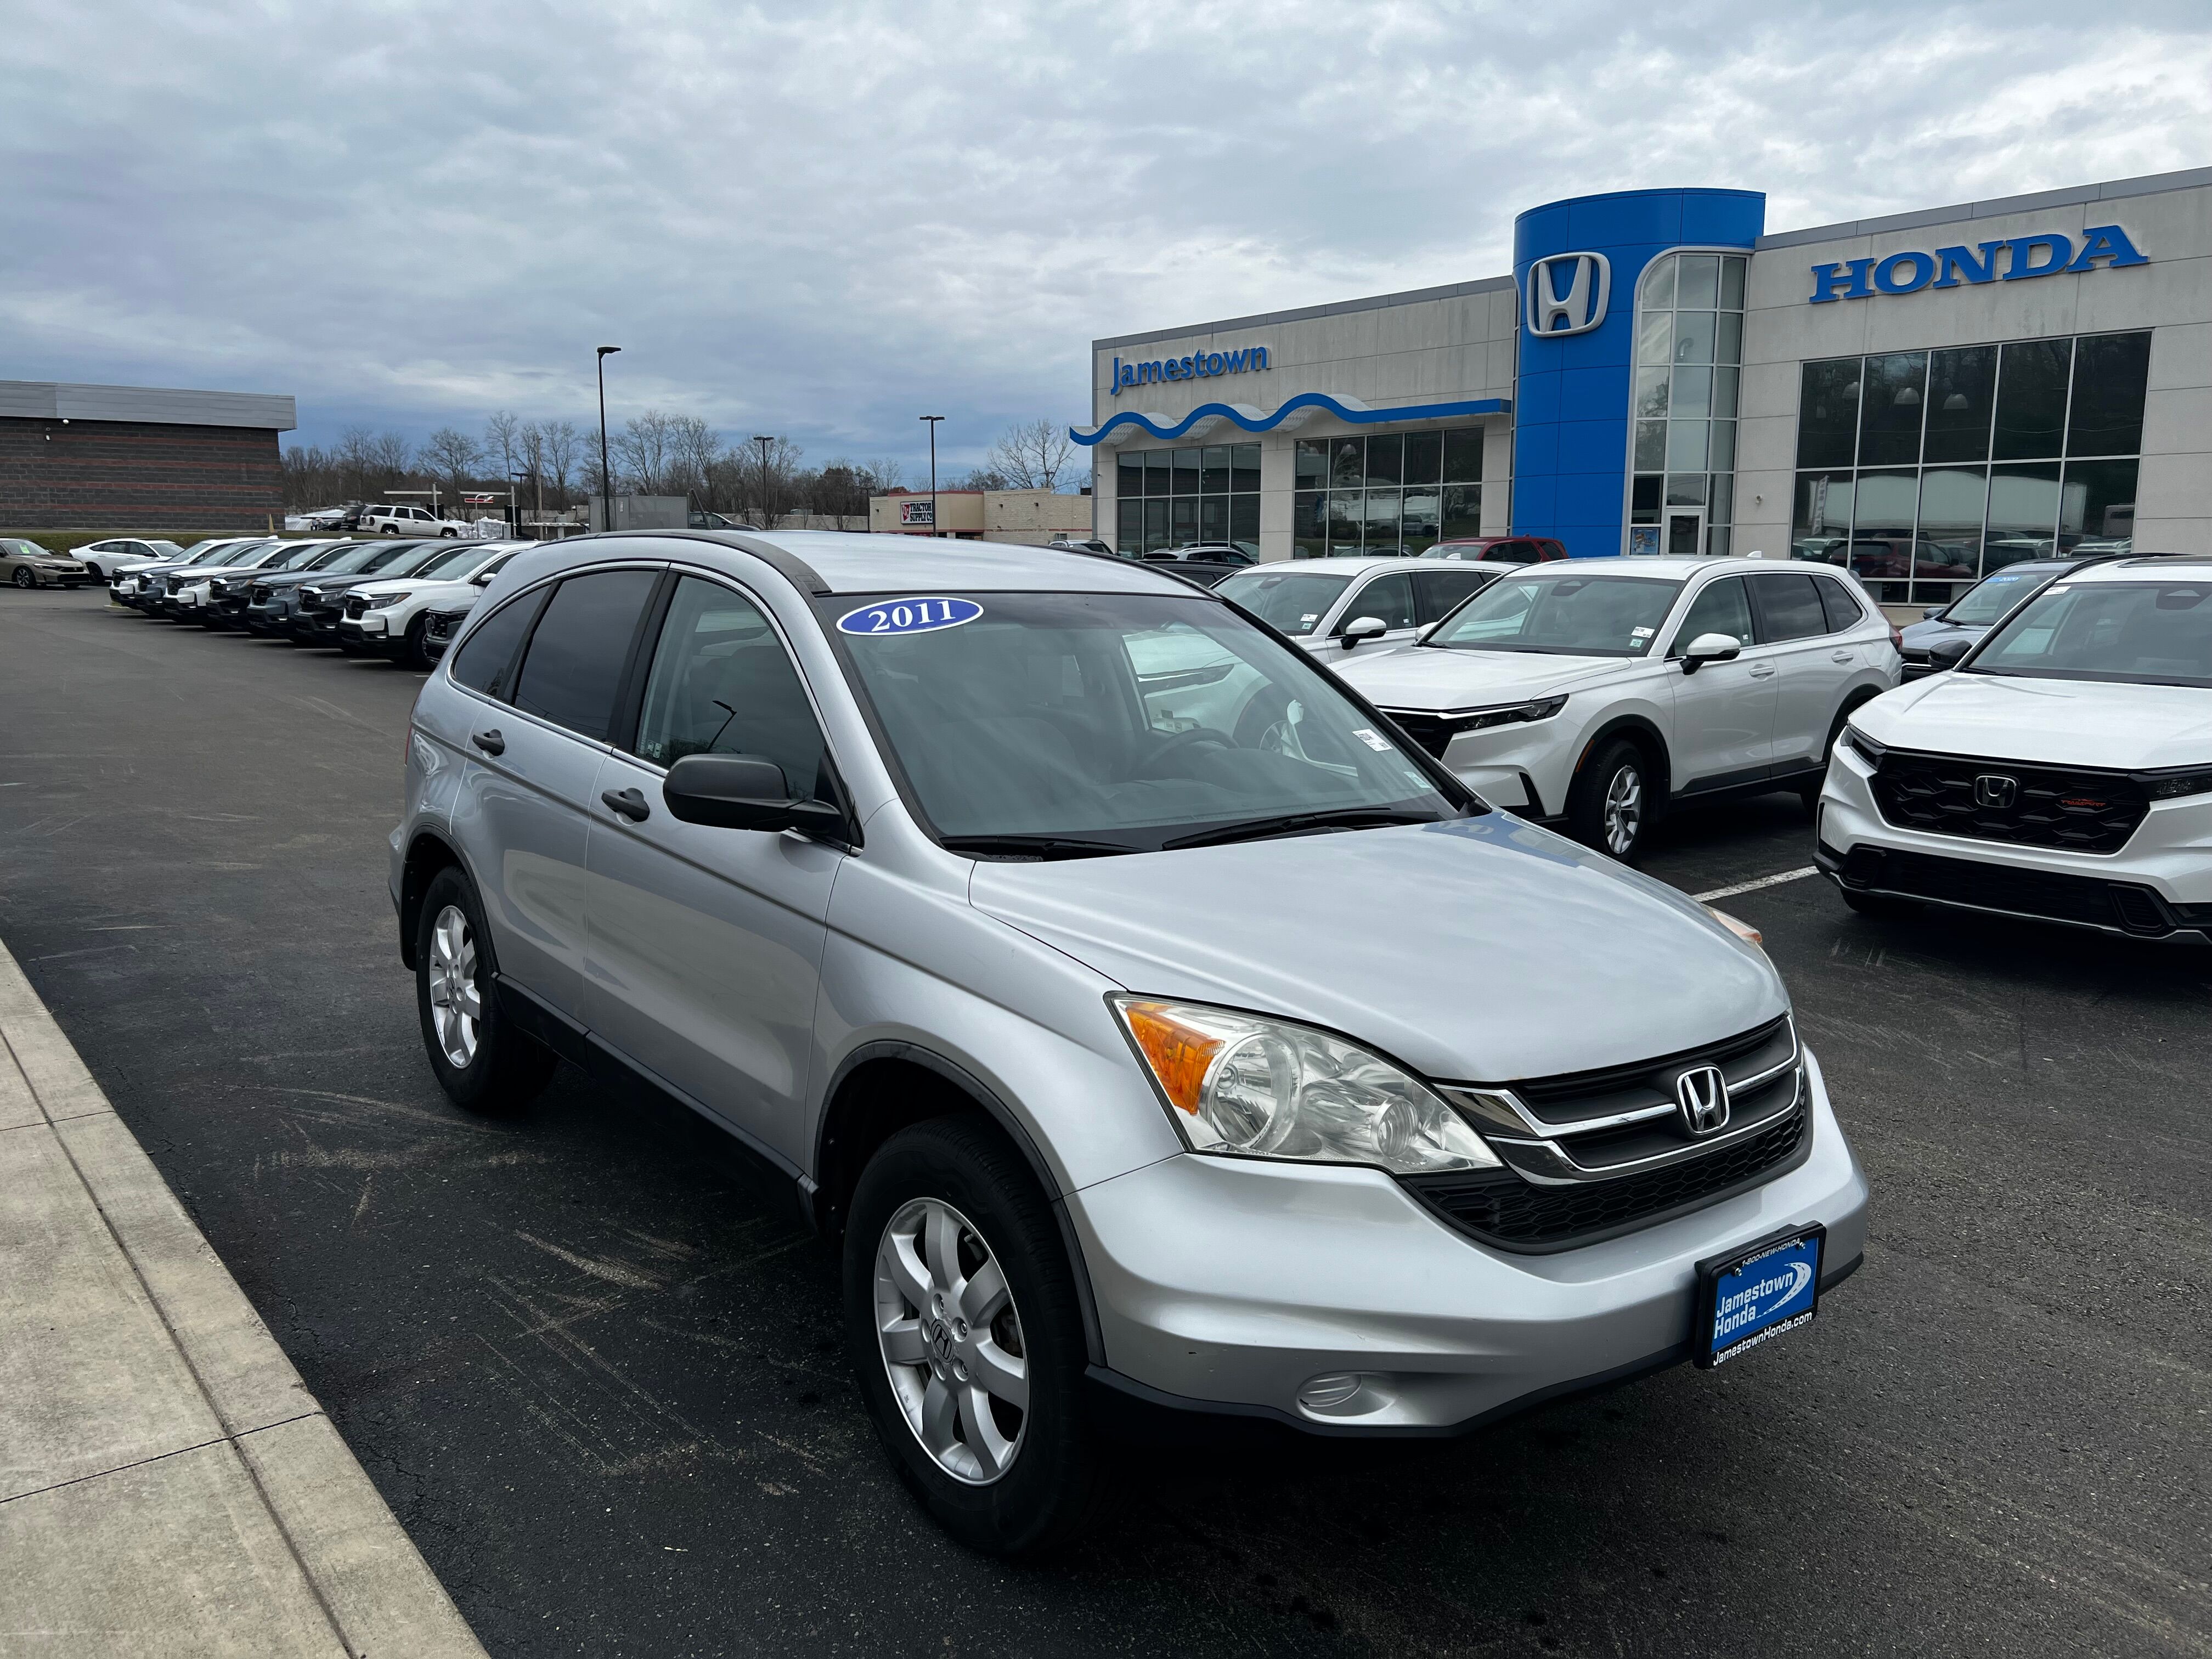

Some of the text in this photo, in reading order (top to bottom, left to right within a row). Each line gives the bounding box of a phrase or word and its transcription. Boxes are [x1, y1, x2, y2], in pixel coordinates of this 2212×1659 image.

[1809, 225, 2149, 303] HONDA
[1110, 346, 1270, 396] Jamestown
[910, 503, 932, 512] TRACTOR
[910, 512, 926, 522] SUPPLY
[868, 600, 956, 632] 2011
[1717, 1272, 1793, 1318] Jamestown
[1713, 1312, 1813, 1366] JamestownHonda.com
[1714, 1303, 1756, 1339] Honda
